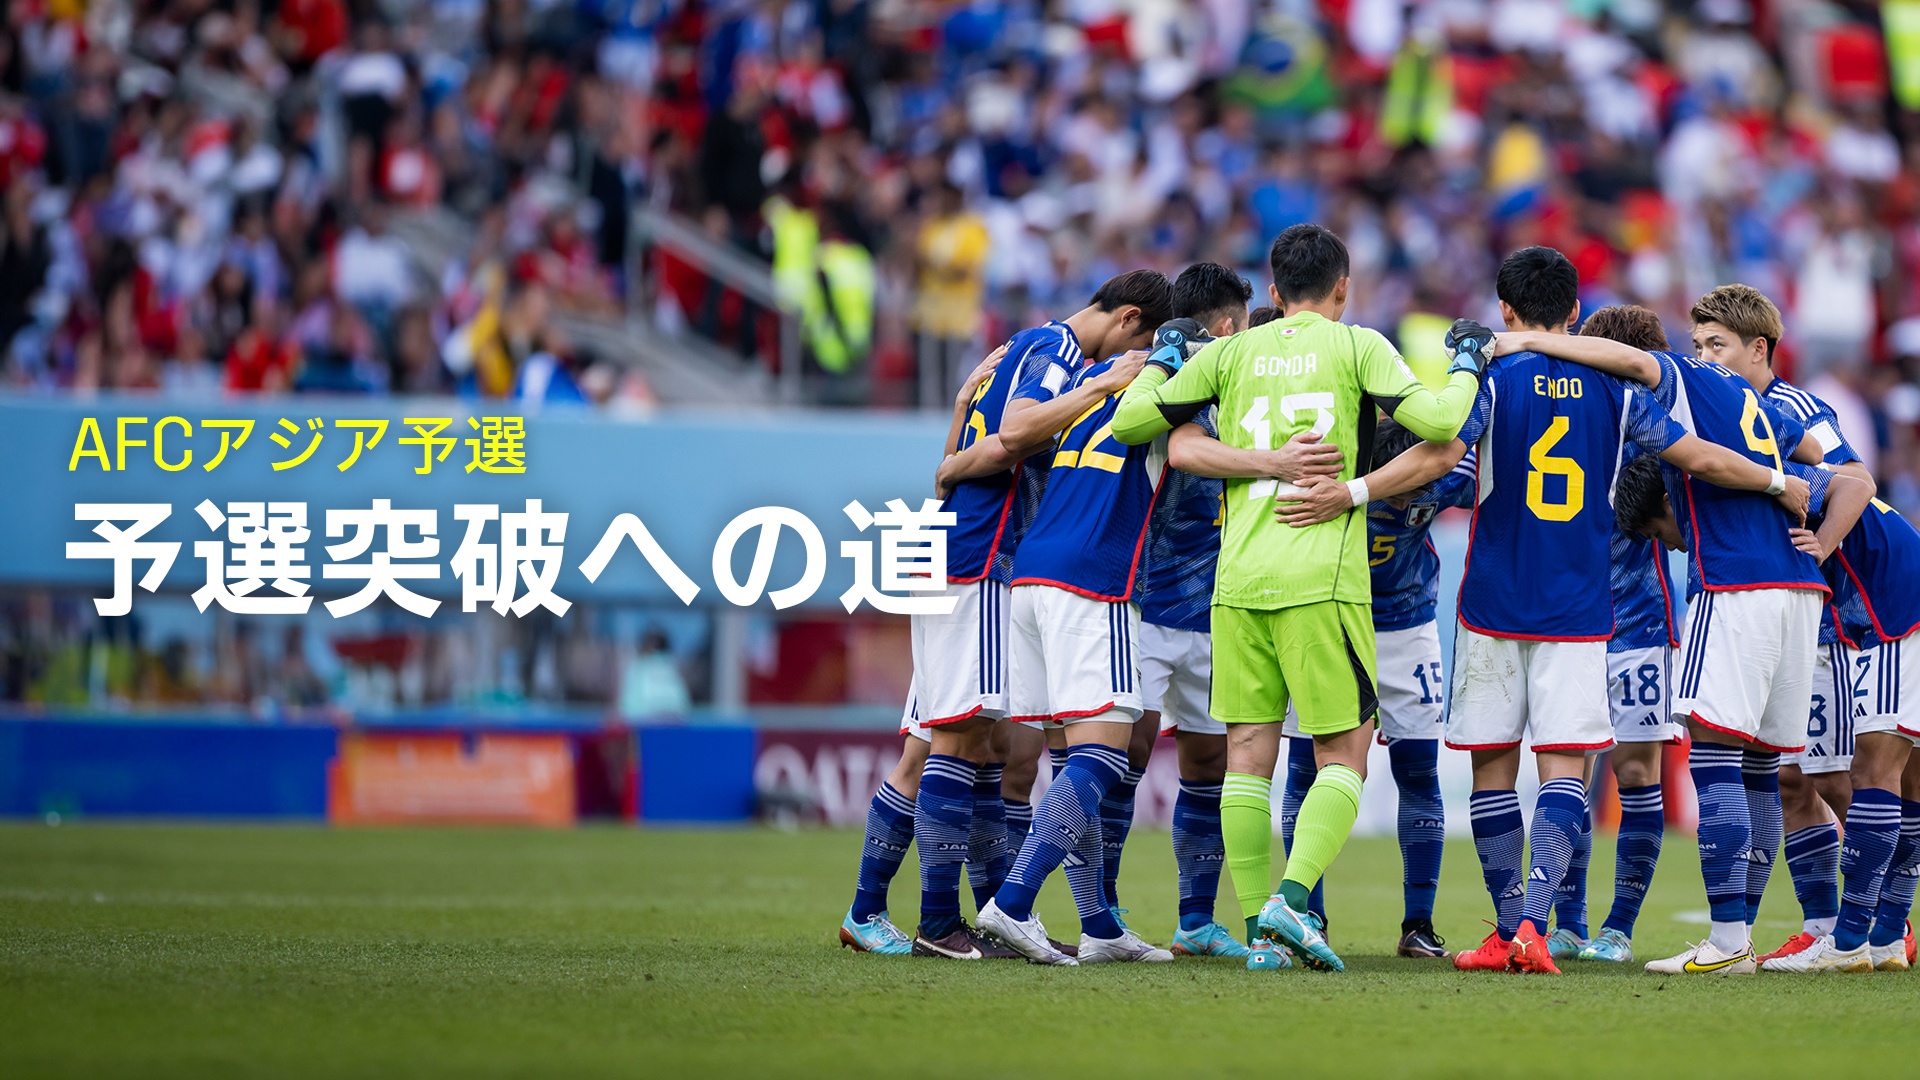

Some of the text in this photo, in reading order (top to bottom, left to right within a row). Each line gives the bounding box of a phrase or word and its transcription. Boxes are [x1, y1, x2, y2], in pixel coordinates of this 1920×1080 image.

[1254, 352, 1317, 377] GONDA
[1533, 374, 1584, 400] ENDO
[1525, 416, 1585, 522] 6
[1617, 663, 1662, 706] 18
[1852, 654, 1872, 699] 2
[1806, 694, 1828, 737] 8
[1414, 820, 1444, 828] JAP
[870, 837, 908, 853] JAPA
[938, 843, 968, 851] JAP
